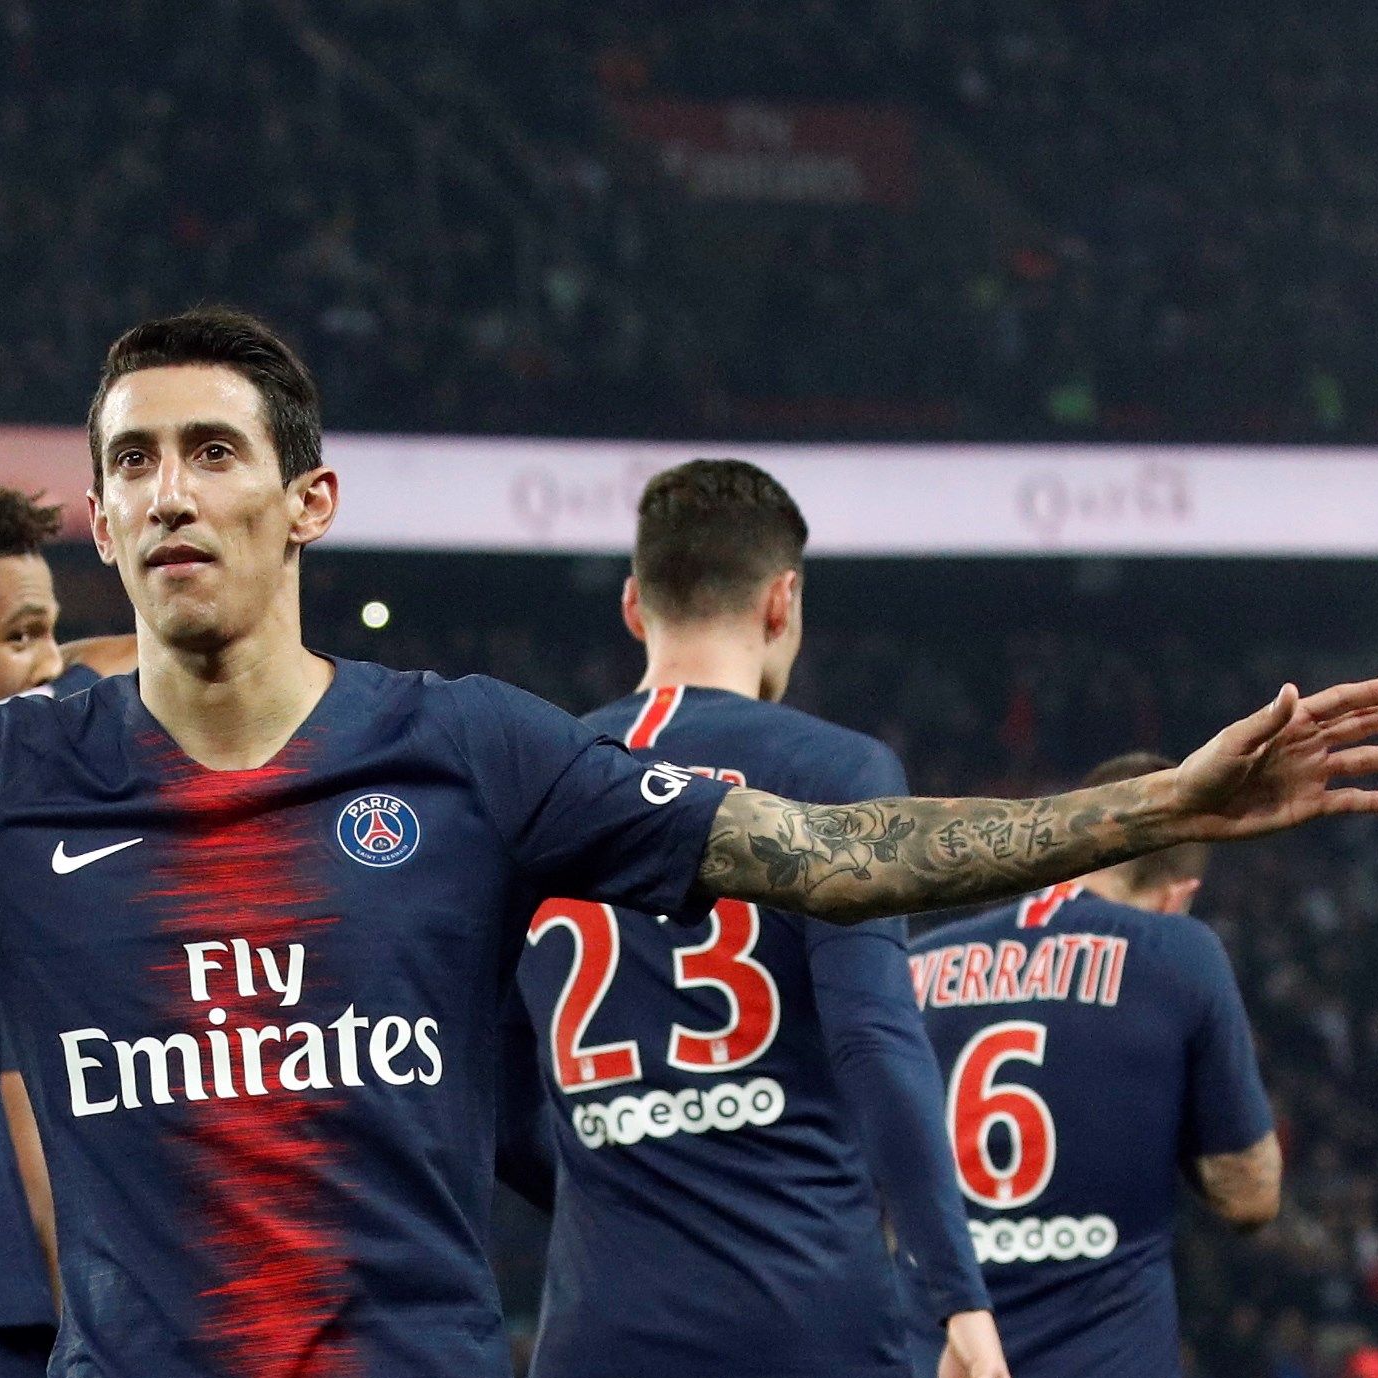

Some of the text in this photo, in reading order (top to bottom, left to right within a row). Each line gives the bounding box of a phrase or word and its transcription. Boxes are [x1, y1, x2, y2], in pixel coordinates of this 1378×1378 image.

[347, 797, 402, 819] PARIS
[640, 760, 692, 806] QN
[183, 938, 307, 1006] Fly
[525, 896, 782, 1095] 23
[908, 932, 1129, 1012] VERRATTI
[58, 1004, 444, 1118] Emirates
[946, 1019, 1057, 1210] 6
